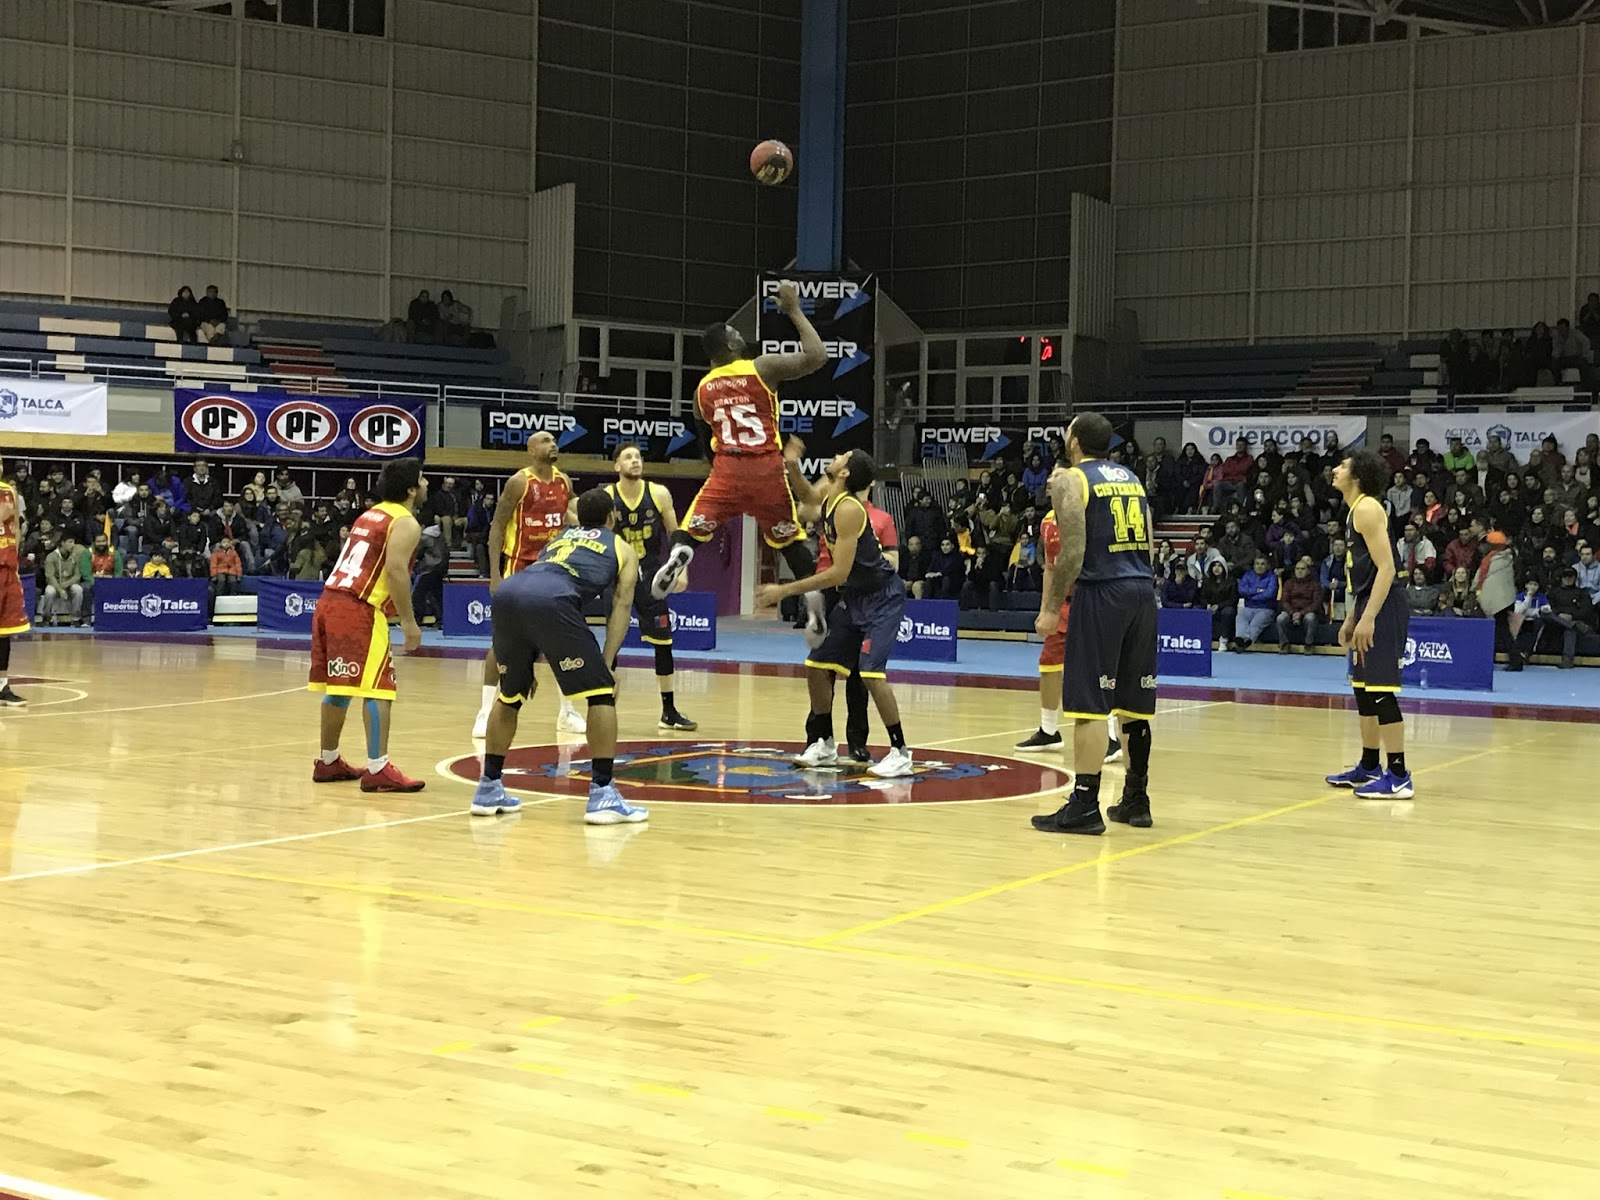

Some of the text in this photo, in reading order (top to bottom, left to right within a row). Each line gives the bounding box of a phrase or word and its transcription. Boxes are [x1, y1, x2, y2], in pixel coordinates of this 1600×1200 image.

[762, 341, 857, 358] POER
[21, 398, 64, 410] TALCA
[202, 407, 238, 438] PF
[286, 411, 322, 442] PF
[489, 411, 576, 432] POWER
[603, 418, 686, 437] POWER
[713, 404, 767, 446] 15
[368, 415, 402, 445] PF
[921, 427, 1001, 443] POWER
[1445, 428, 1478, 437] ACTIVA
[545, 513, 561, 527] 33
[1110, 496, 1146, 542] 14
[103, 603, 138, 611] Deportes
[163, 600, 198, 610] Talca
[678, 615, 709, 627] Talca
[915, 623, 950, 636] Talca
[1160, 635, 1201, 649] Talca
[1419, 642, 1450, 650] ACTIVA
[1418, 649, 1452, 660] TALCA
